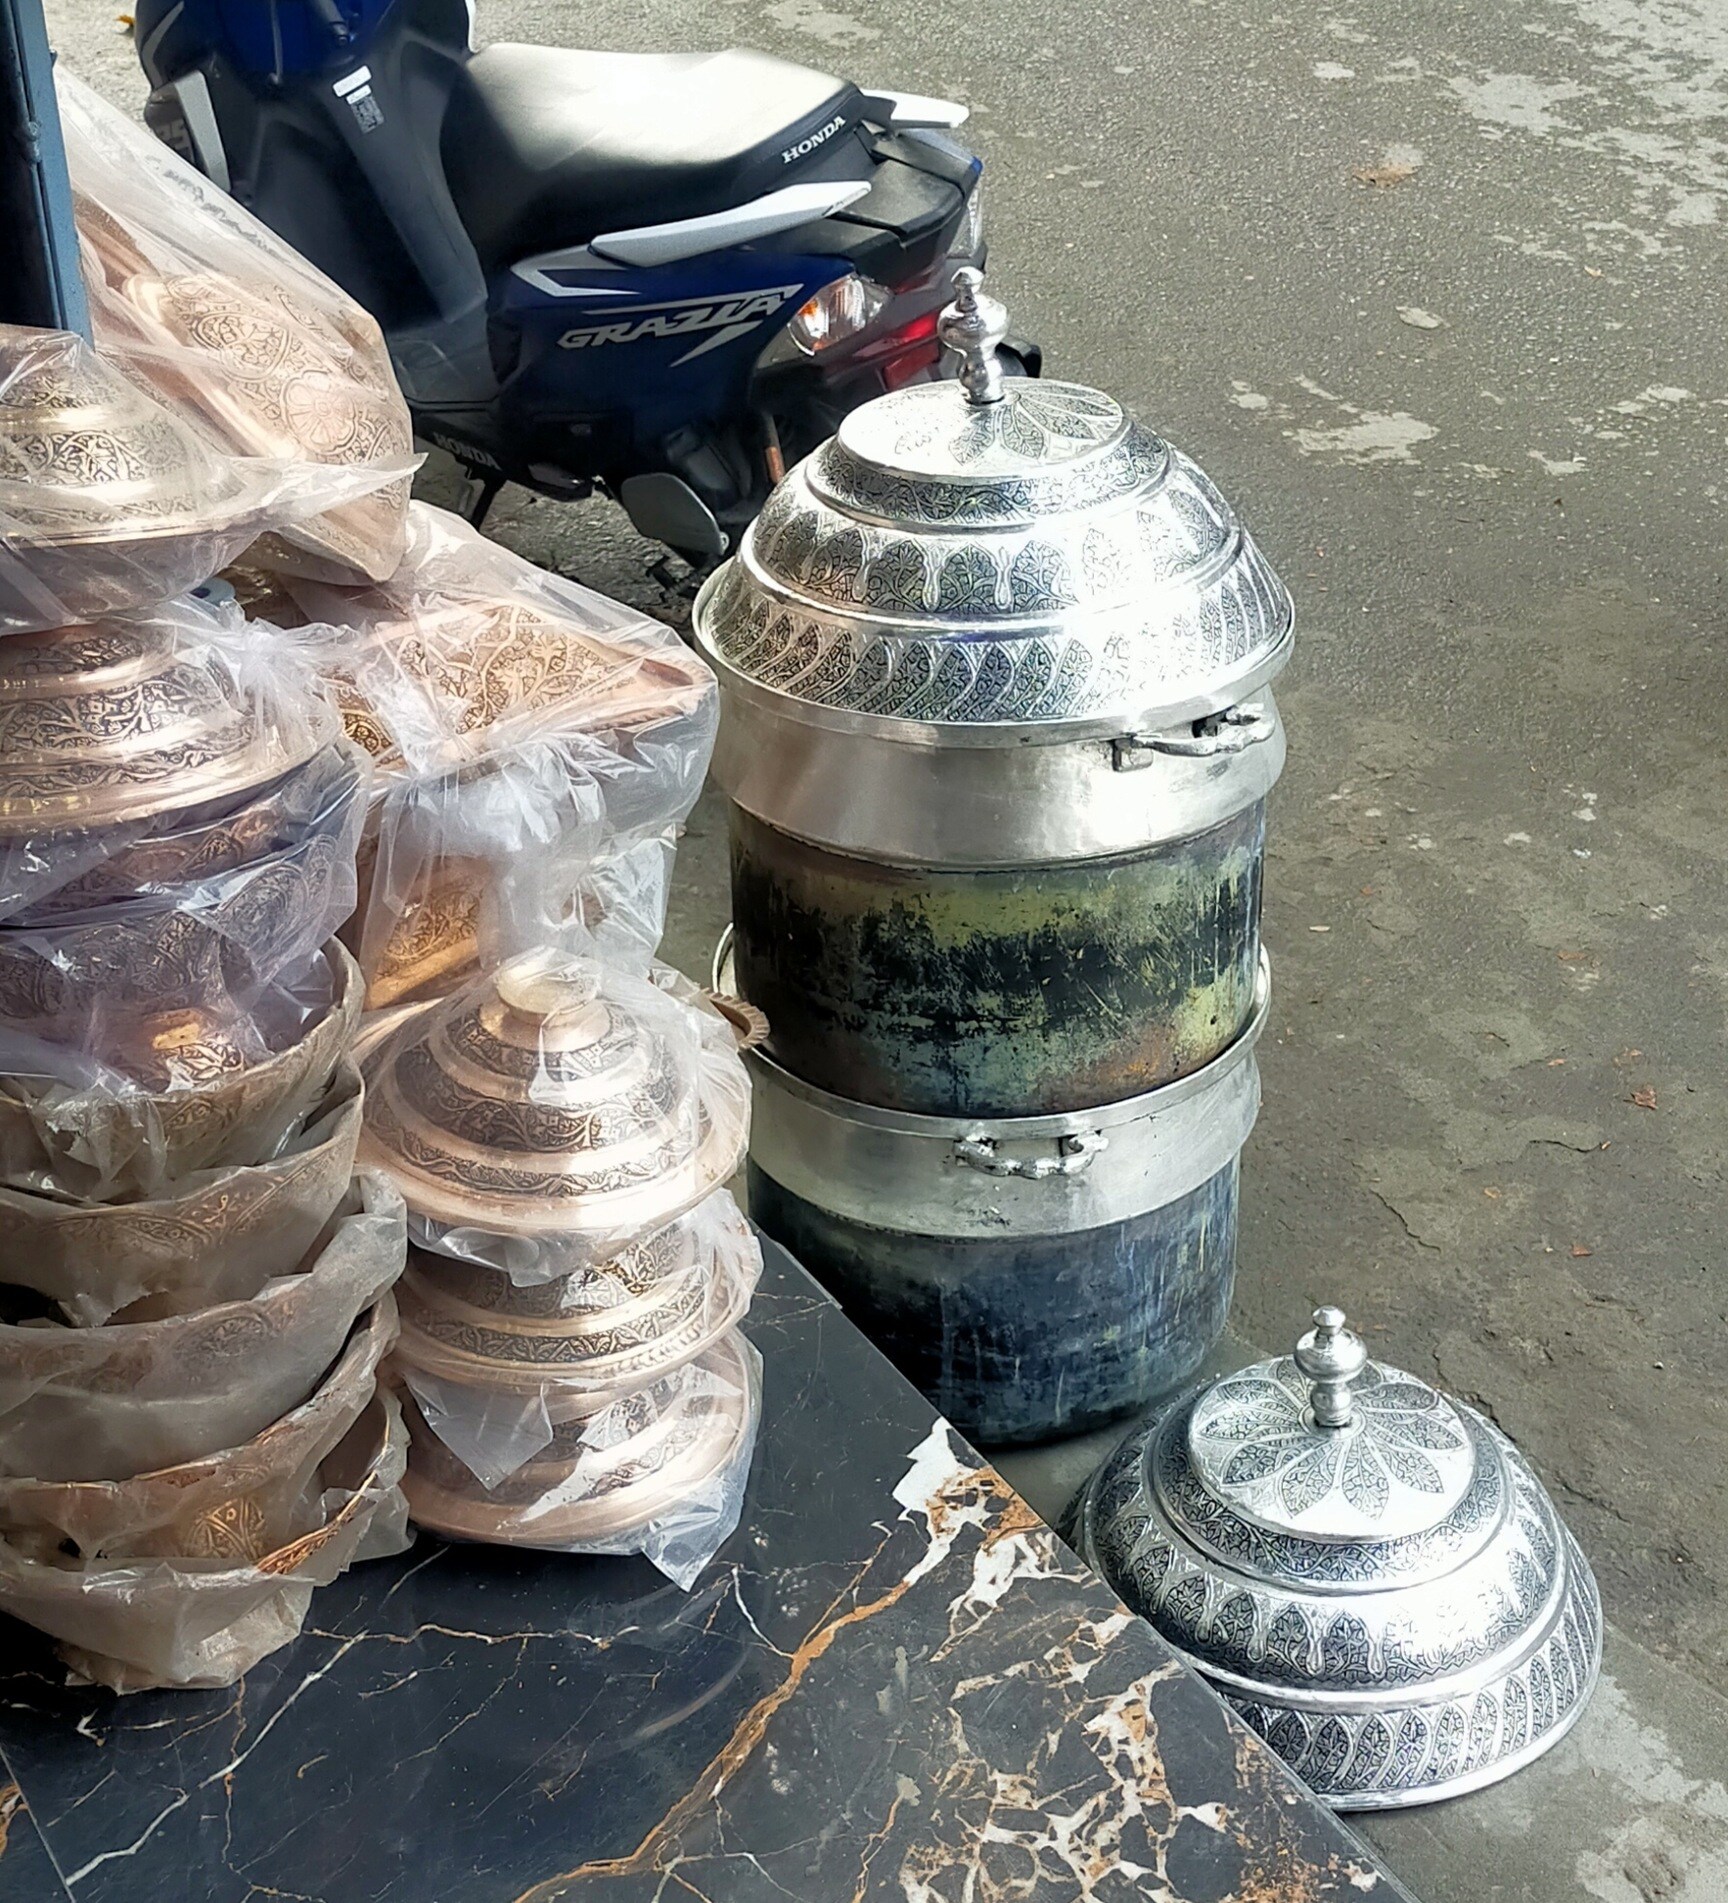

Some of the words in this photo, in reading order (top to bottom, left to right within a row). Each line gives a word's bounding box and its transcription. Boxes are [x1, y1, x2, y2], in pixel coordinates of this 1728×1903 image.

[781, 115, 847, 164] HONDA
[556, 288, 794, 349] GRAZIA
[432, 431, 503, 472] HONDA
